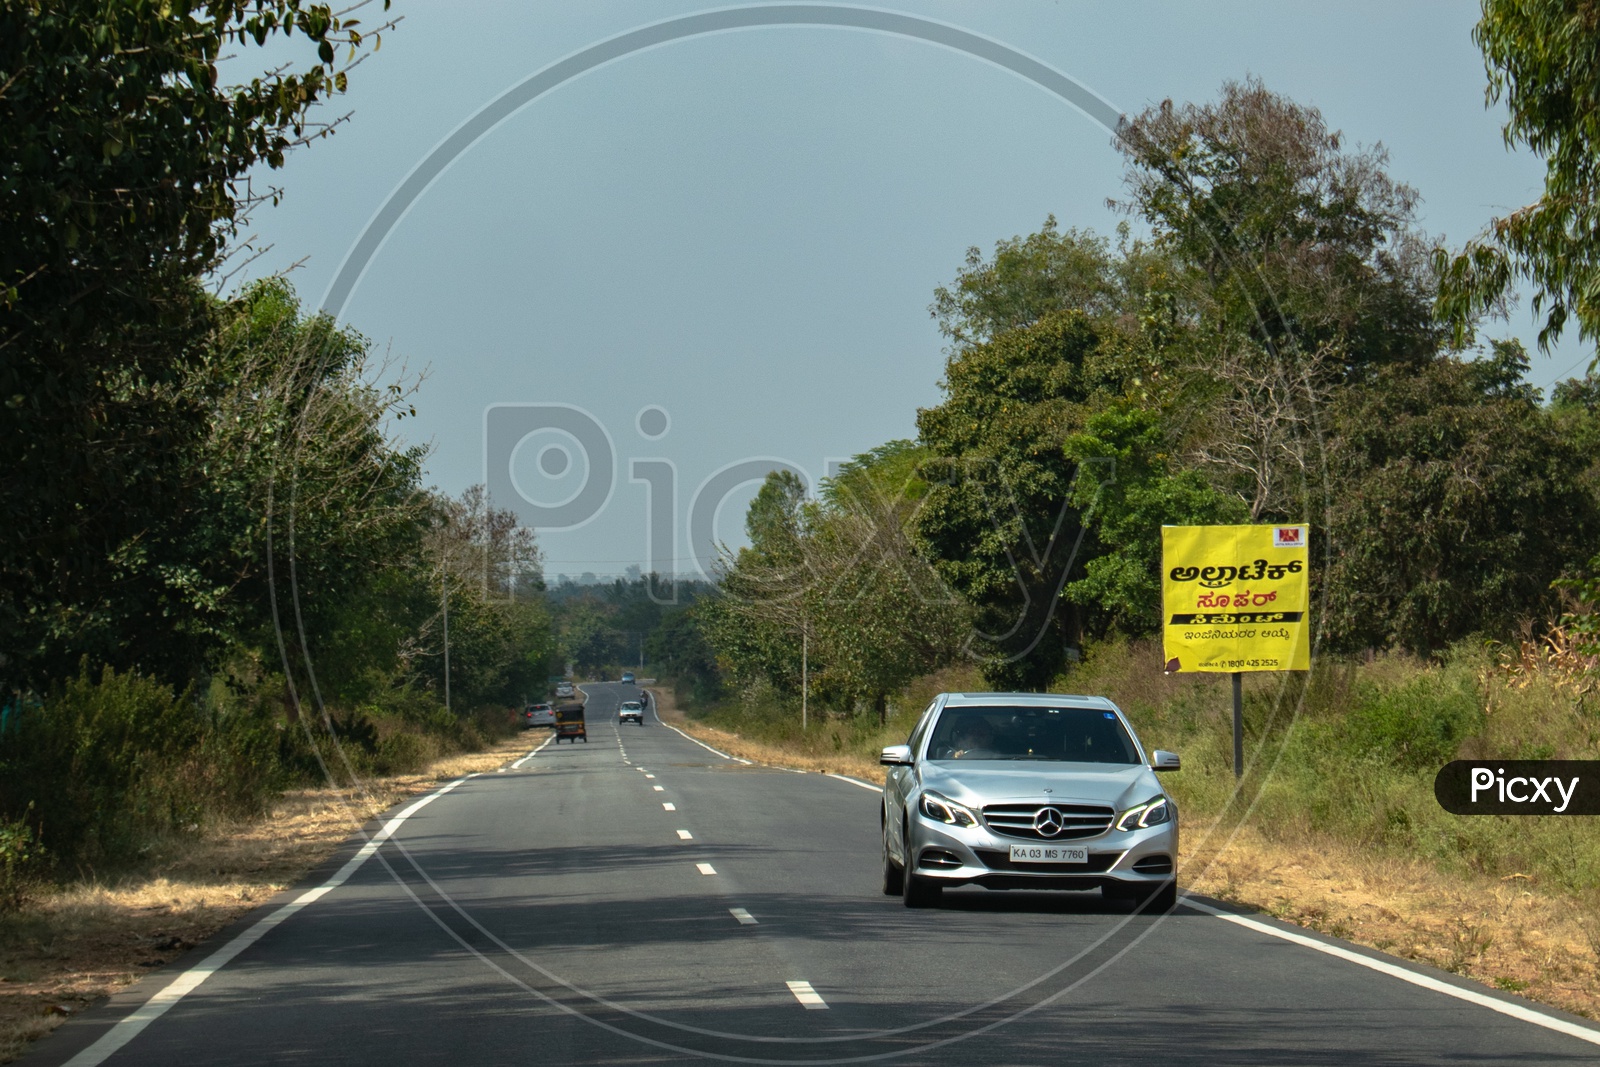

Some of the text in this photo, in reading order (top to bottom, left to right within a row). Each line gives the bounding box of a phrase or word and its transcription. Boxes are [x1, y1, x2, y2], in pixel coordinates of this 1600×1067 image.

[1169, 559, 1303, 588] ಅಲ್ಟ್ರಾಟೆಕ್
[1197, 590, 1277, 608] ಸೂಪರ್
[1190, 613, 1284, 624] ಸಿಮೆಂಟ್
[1228, 659, 1279, 668] 1800 425 2525
[1013, 849, 1084, 859] KA 03 MS 7760
